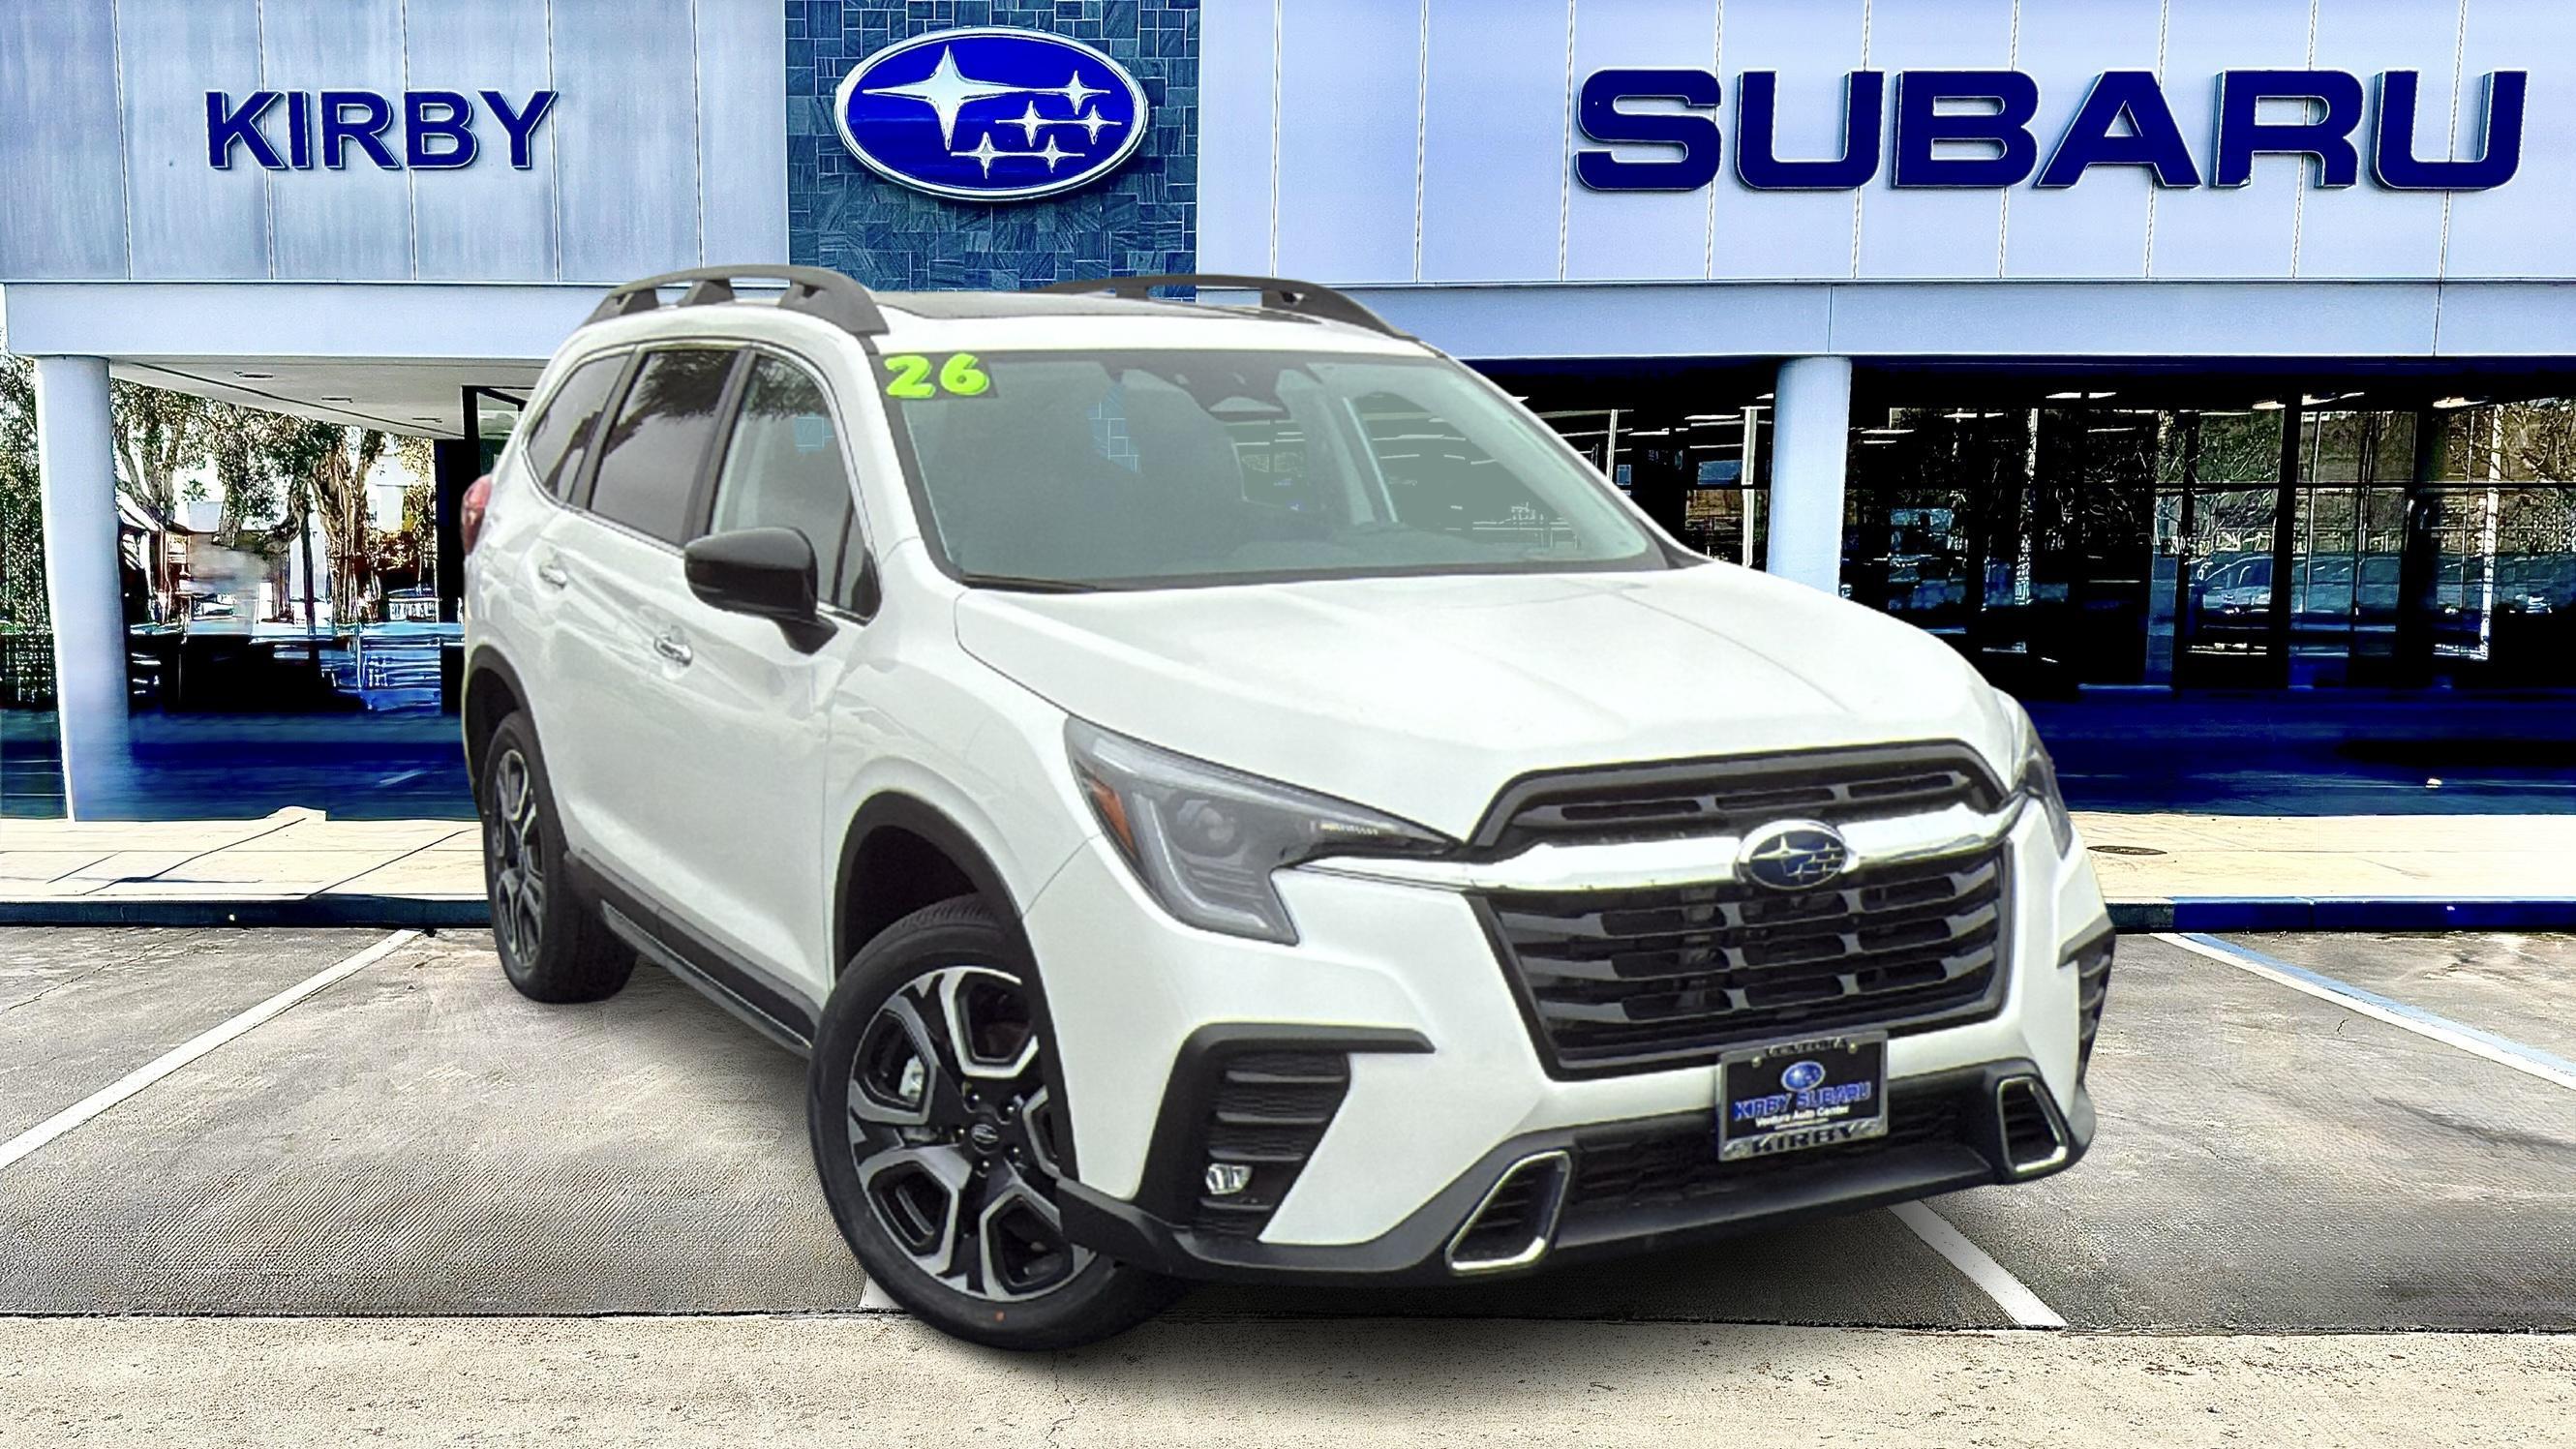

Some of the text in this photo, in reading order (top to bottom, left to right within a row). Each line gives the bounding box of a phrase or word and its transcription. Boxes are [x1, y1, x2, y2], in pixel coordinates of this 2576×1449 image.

[204, 89, 559, 170] KIRBY
[1575, 69, 2528, 193] SUBARU
[884, 352, 990, 399] 26
[1733, 1082, 1871, 1122] KIRBY SUBARU
[1755, 1114, 1791, 1128] Ventura
[1793, 1109, 1816, 1121] Auto
[1816, 1104, 1850, 1117] Center
[1752, 1124, 1856, 1153] KIRBY
